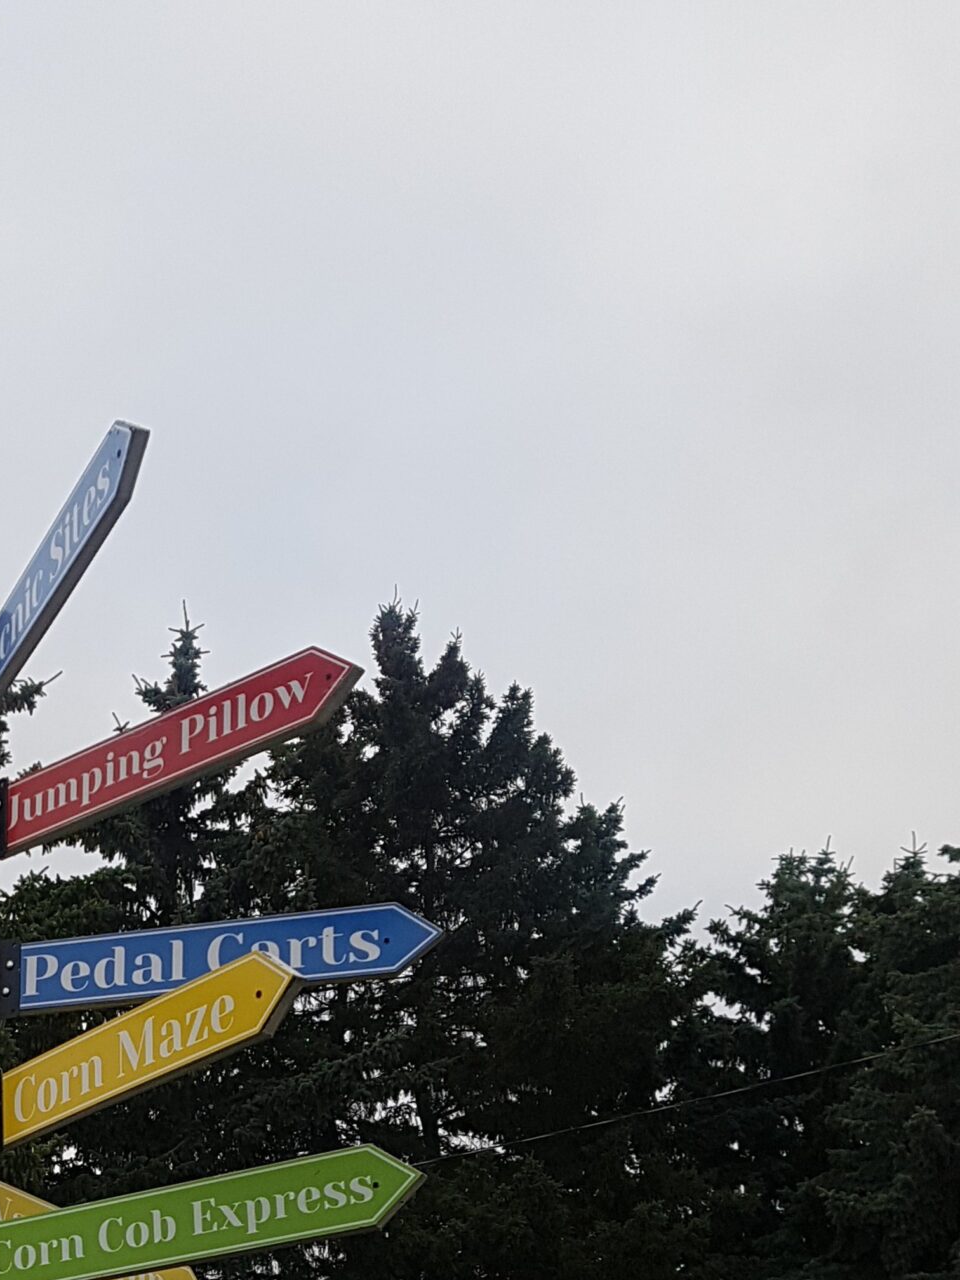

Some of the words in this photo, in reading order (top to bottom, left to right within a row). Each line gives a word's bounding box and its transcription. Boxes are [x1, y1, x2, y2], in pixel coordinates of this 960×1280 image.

[49, 460, 110, 583] Sites
[7, 737, 166, 831] Jumping
[179, 671, 313, 754] Pillow
[21, 940, 187, 997] Pedal
[14, 1055, 103, 1123] Corn
[117, 994, 235, 1079] Maze
[98, 1209, 176, 1253] Cob
[191, 1174, 374, 1236] Express
